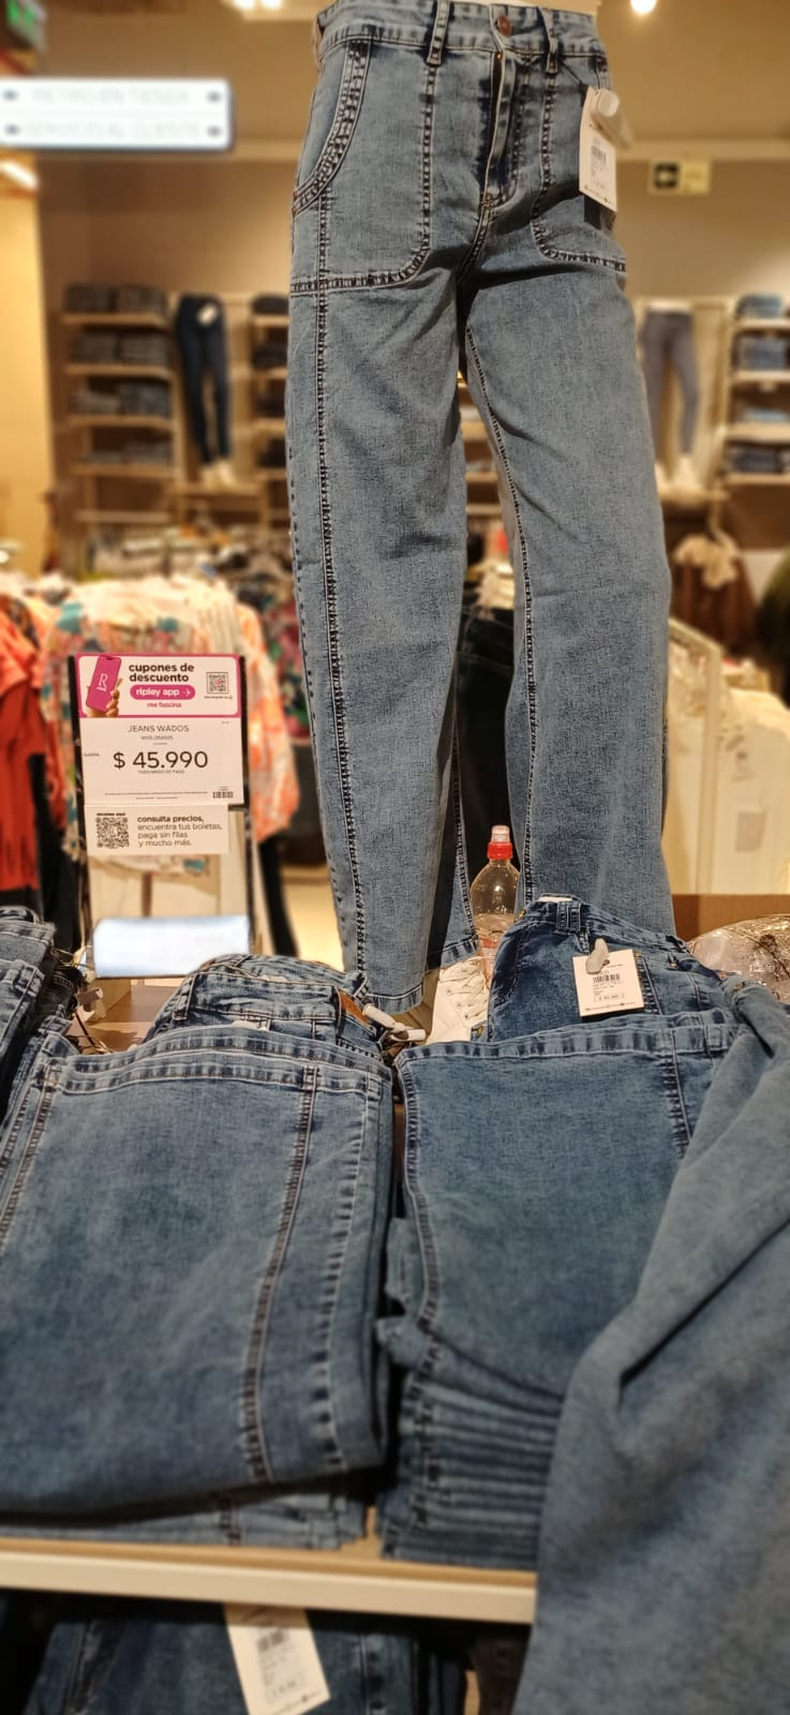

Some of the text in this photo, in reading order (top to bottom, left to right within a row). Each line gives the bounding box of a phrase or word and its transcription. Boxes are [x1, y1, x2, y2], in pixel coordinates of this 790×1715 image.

[128, 662, 195, 674] cupones de
[129, 673, 189, 682] descuento
[136, 688, 180, 697] ripley app
[113, 750, 208, 770] $ 45.990
[137, 815, 171, 823] consulta
[137, 823, 177, 831] encuentra
[137, 832, 158, 840] paga
